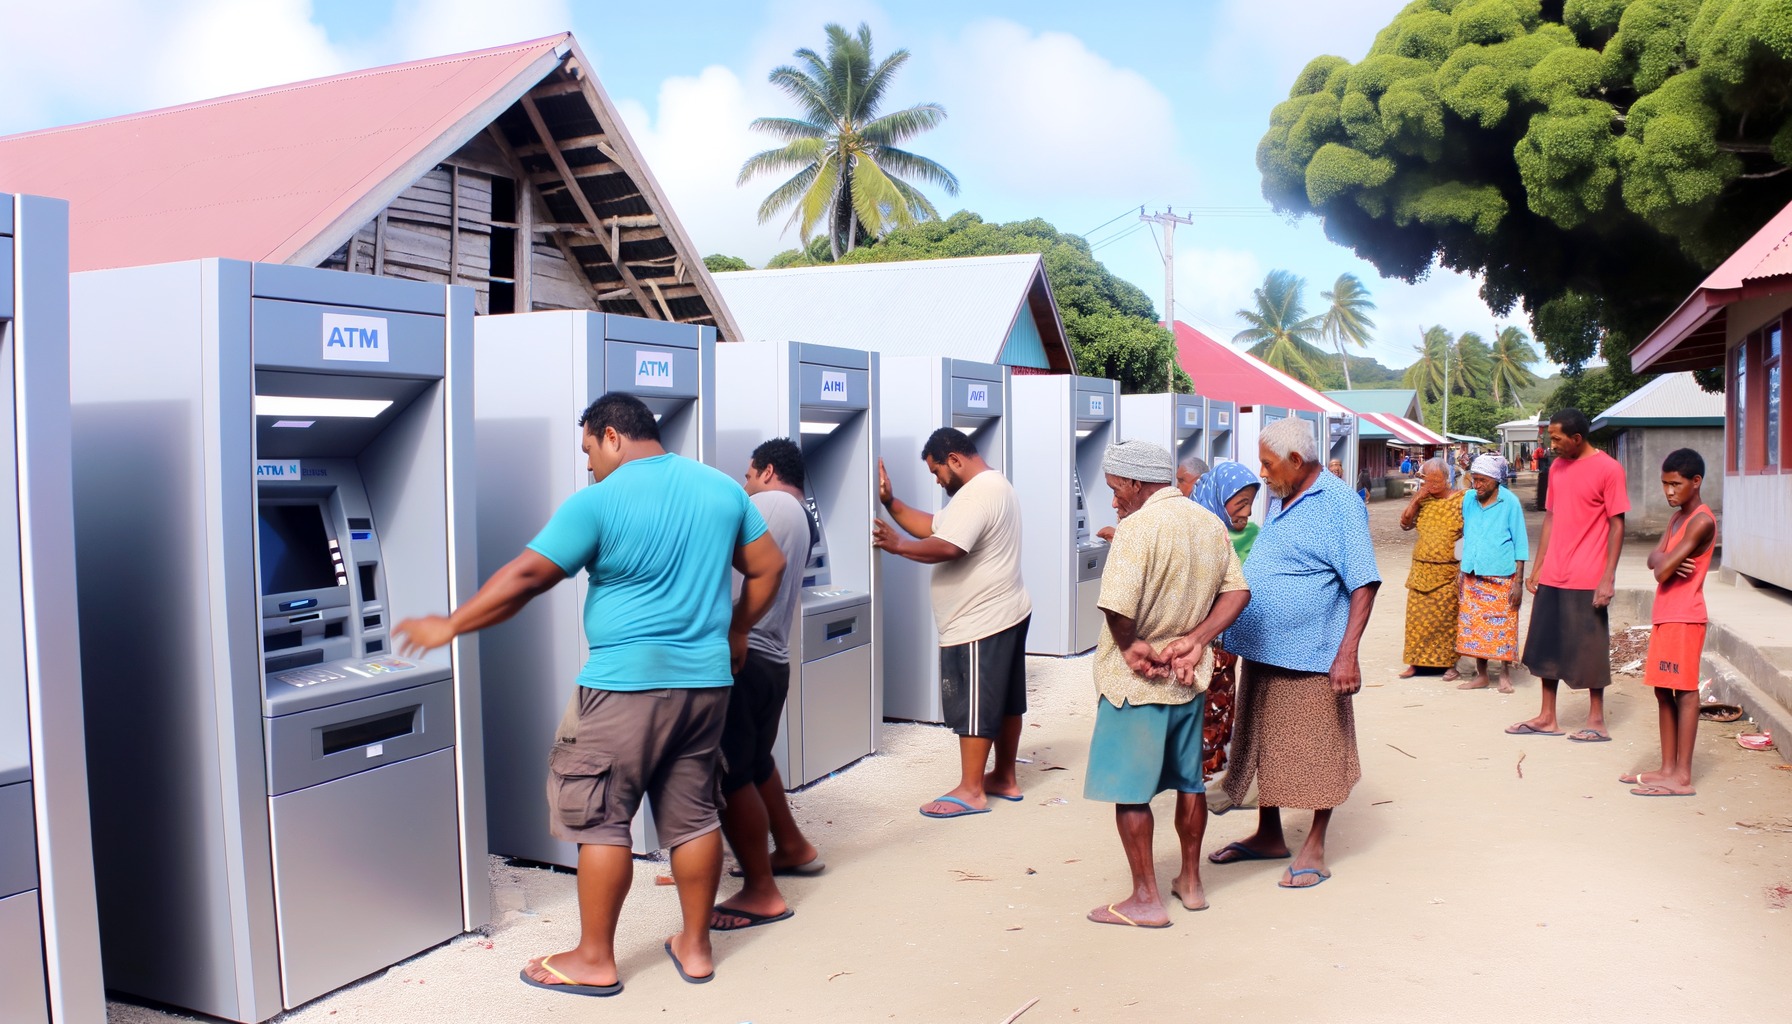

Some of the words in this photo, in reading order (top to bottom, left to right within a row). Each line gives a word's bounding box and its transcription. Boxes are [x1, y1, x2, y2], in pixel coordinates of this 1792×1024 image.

[327, 327, 379, 348] ATM
[639, 361, 669, 377] ATM
[256, 465, 284, 476] ATM
